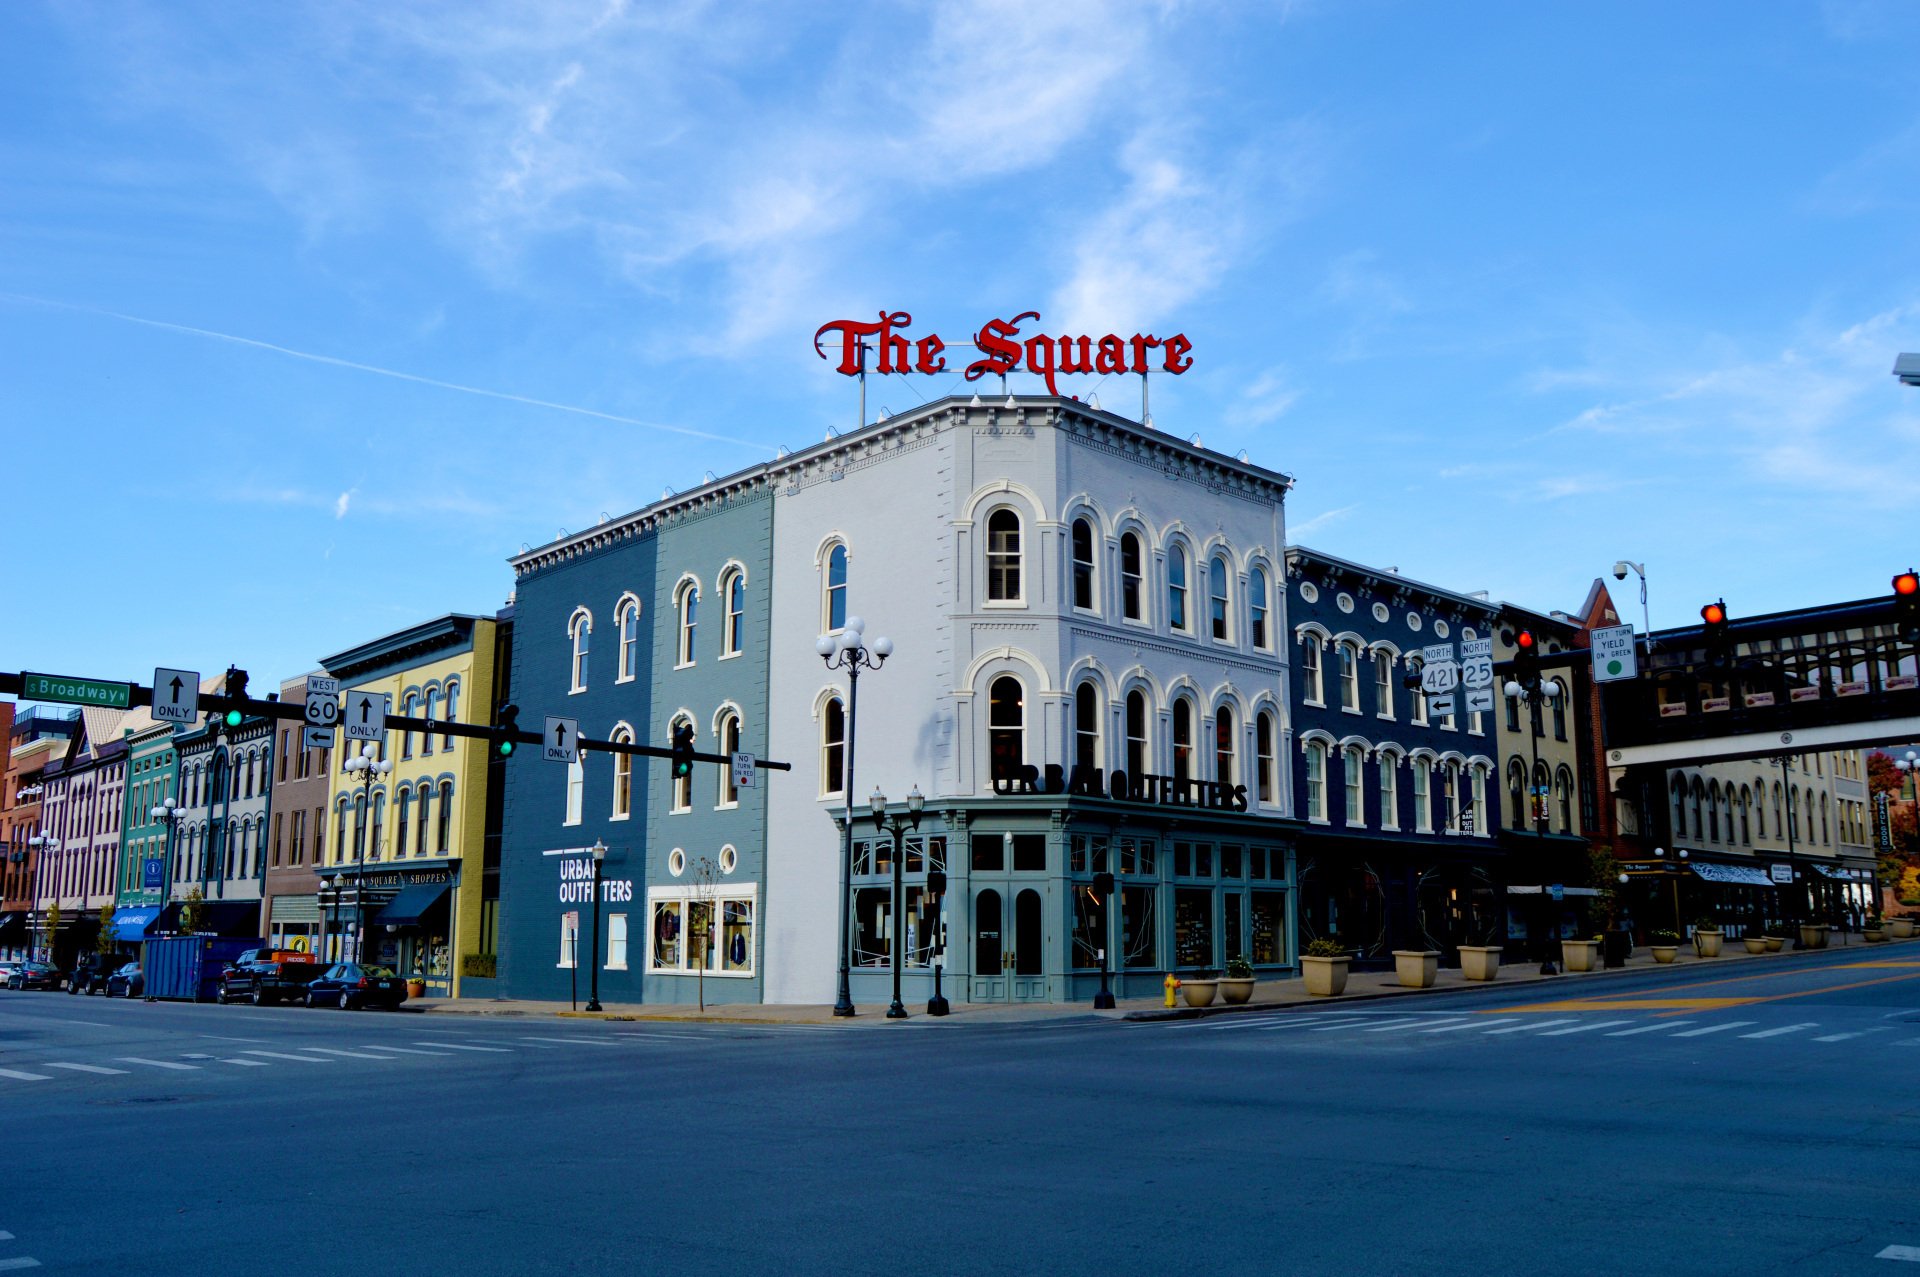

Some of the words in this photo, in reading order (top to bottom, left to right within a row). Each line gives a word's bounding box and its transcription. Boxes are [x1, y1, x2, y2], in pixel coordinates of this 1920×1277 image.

[814, 310, 946, 377] The
[965, 311, 1194, 397] Square
[1593, 631, 1609, 640] LEFT
[1615, 628, 1631, 637] TURN
[1463, 641, 1490, 654] NORTH
[1601, 638, 1625, 650] YIELD
[1425, 647, 1452, 660] NORTH
[1596, 652, 1605, 660] ON
[1611, 649, 1632, 658] GREEN
[1426, 667, 1454, 688] 421
[1465, 663, 1490, 684] 25
[29, 682, 36, 692] S
[39, 679, 118, 703] Broadway
[119, 692, 125, 701] N
[311, 679, 336, 691] WEST
[158, 706, 190, 718] ONLY
[308, 701, 336, 720] 60
[350, 725, 378, 737] ONLY
[548, 748, 572, 760] ONLY
[738, 755, 749, 763] NO
[737, 762, 751, 770] TURN
[1110, 769, 1248, 813] OUTFITTERS
[370, 875, 398, 887] SQUARE
[410, 873, 446, 884] SHOPPES
[560, 880, 632, 903] OUTFITERS
